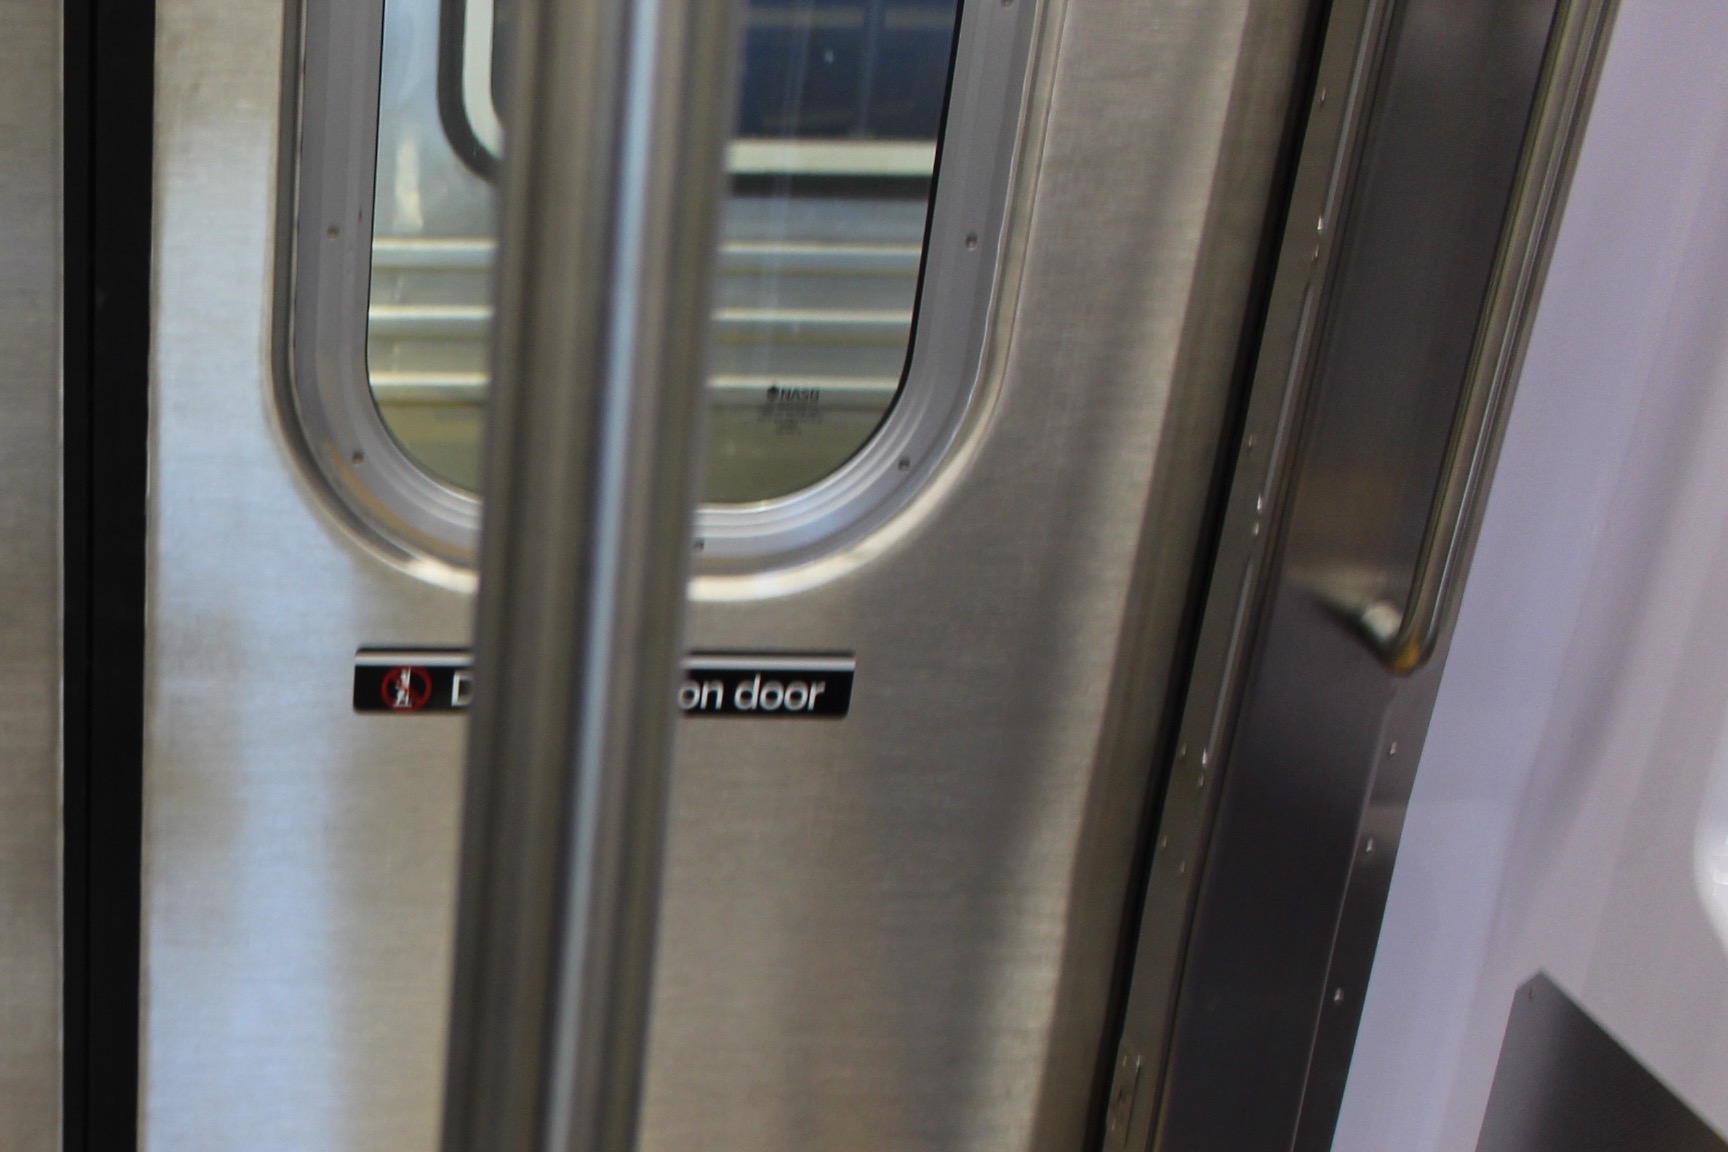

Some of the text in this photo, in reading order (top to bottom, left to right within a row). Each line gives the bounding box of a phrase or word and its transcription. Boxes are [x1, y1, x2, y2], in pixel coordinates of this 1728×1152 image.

[451, 671, 826, 710] D on door
